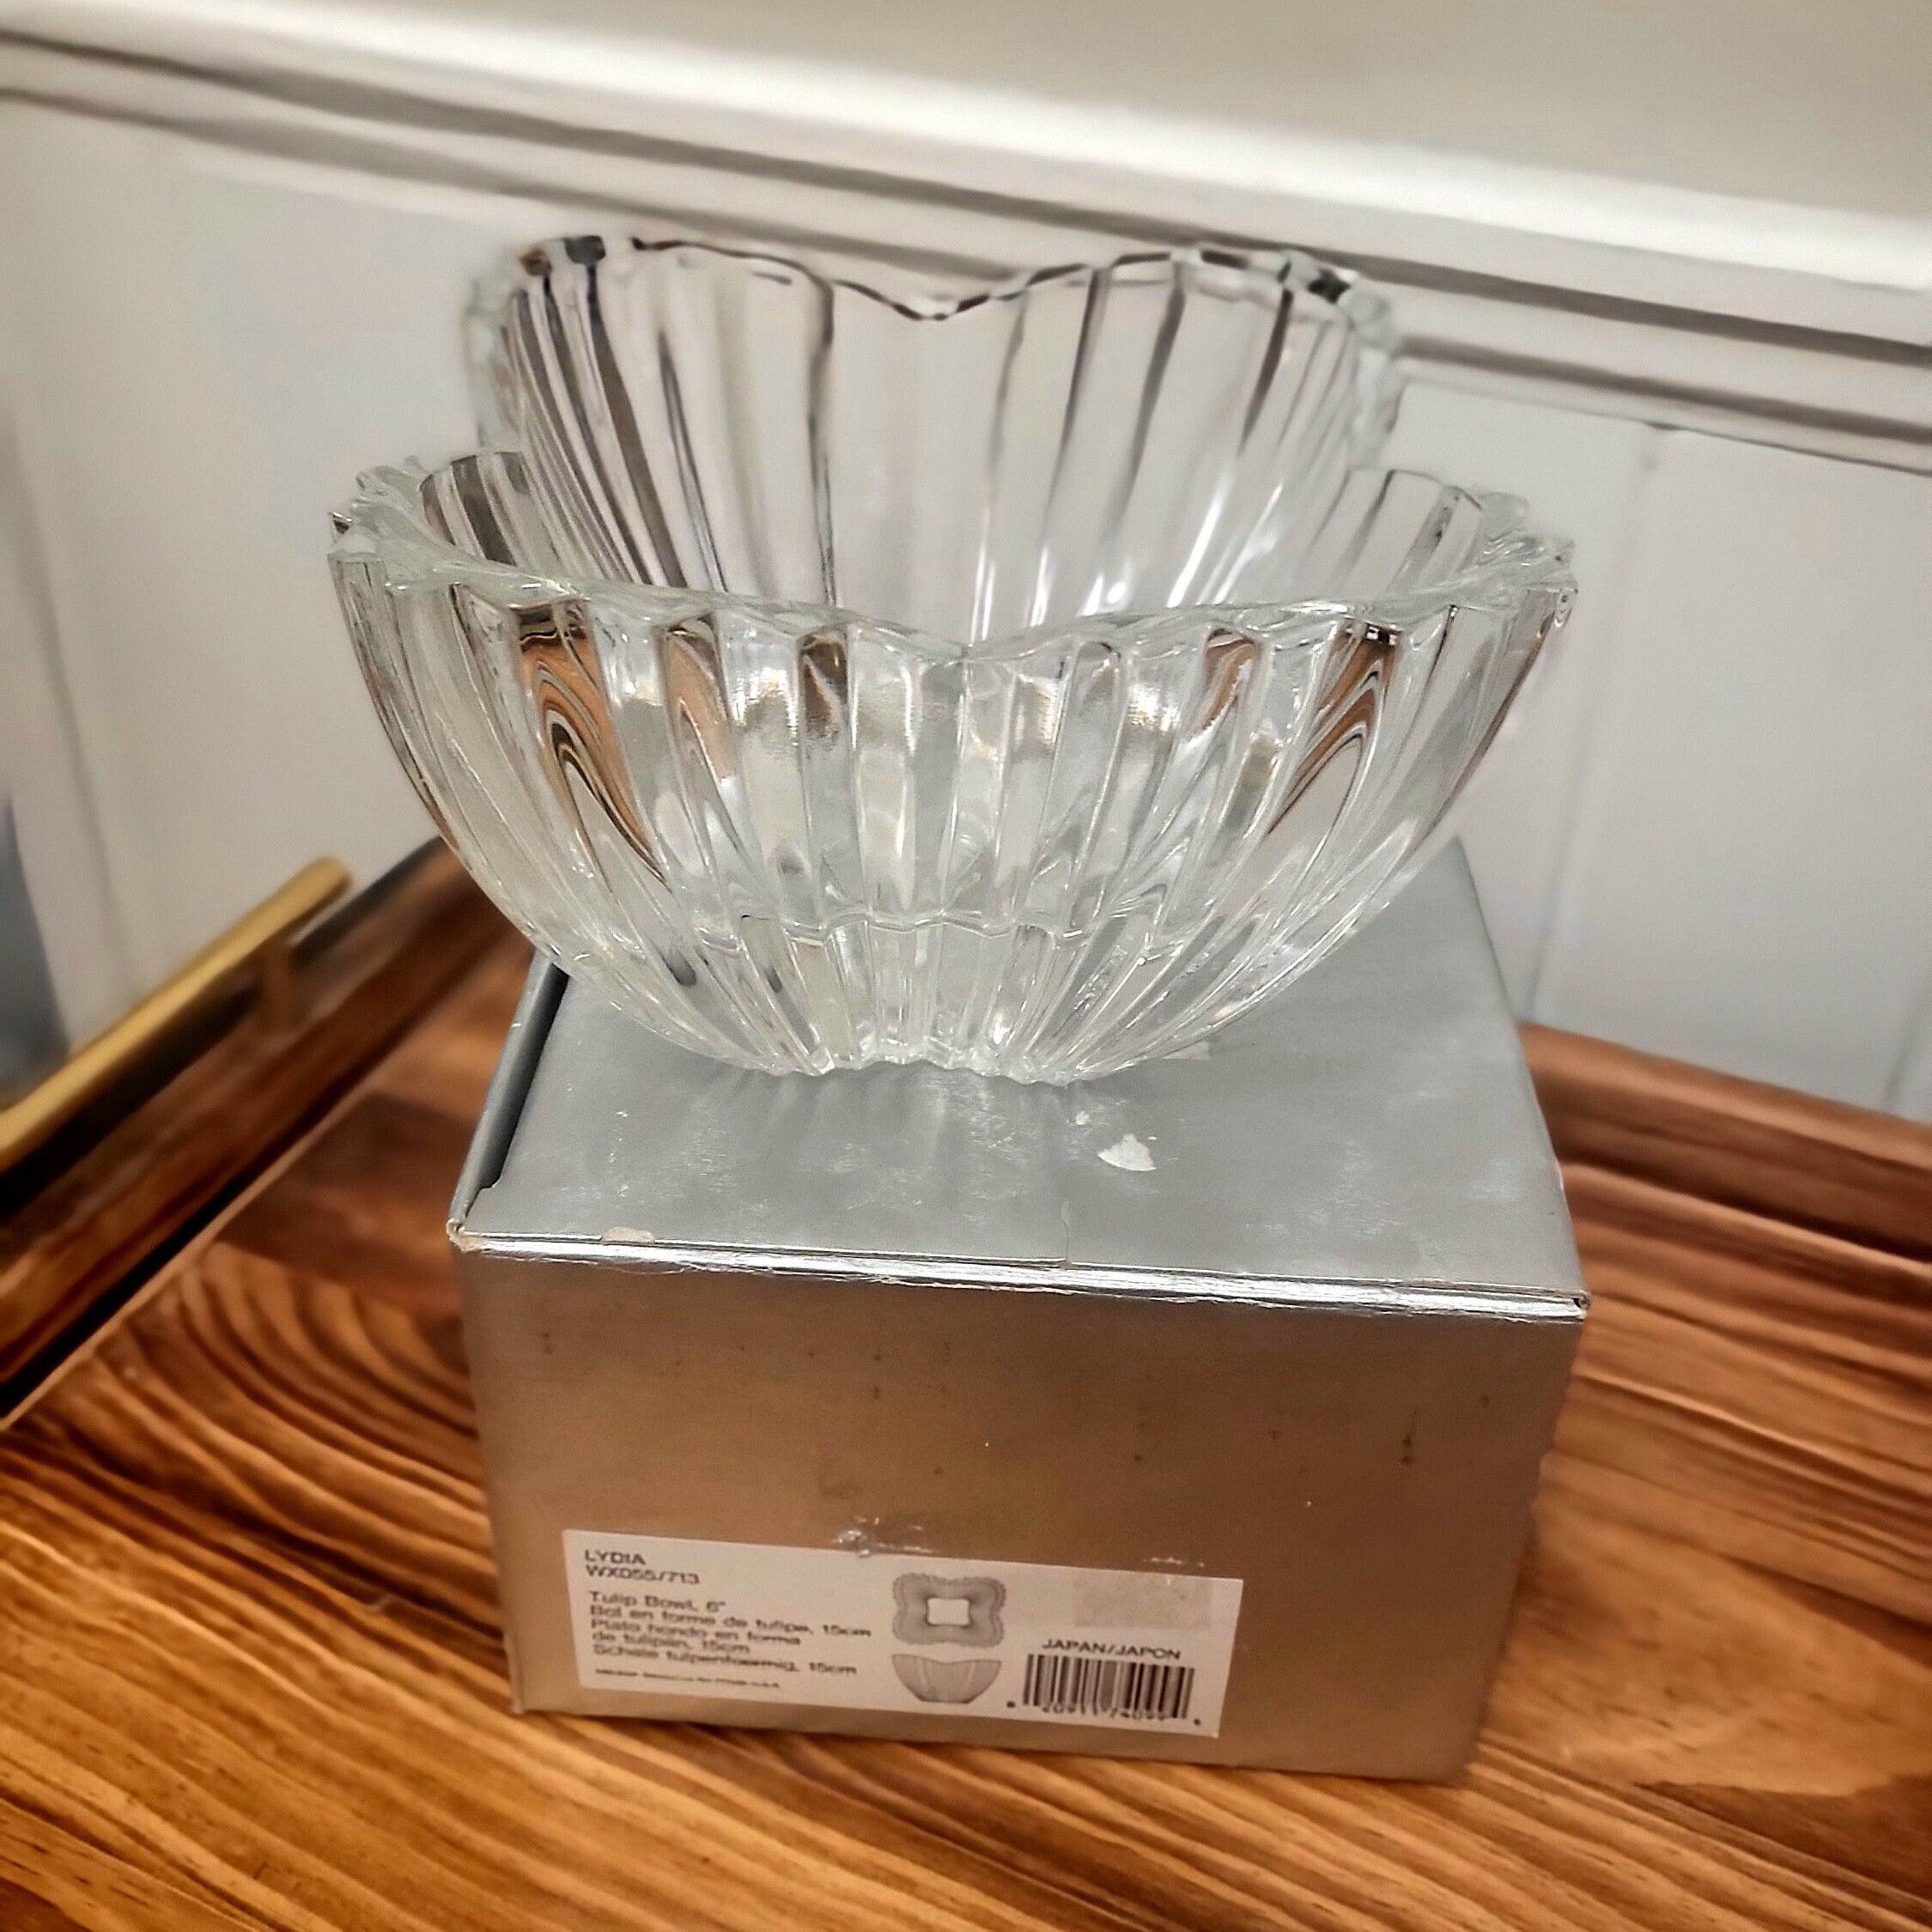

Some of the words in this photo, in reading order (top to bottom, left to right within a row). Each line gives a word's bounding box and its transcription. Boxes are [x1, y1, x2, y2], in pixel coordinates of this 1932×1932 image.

[585, 1550, 646, 1565] LYDIA
[589, 1591, 637, 1607] Tulip
[590, 1605, 622, 1617] Bol
[724, 1616, 748, 1628] de
[1042, 1638, 1182, 1660] JAPAN/JAPON
